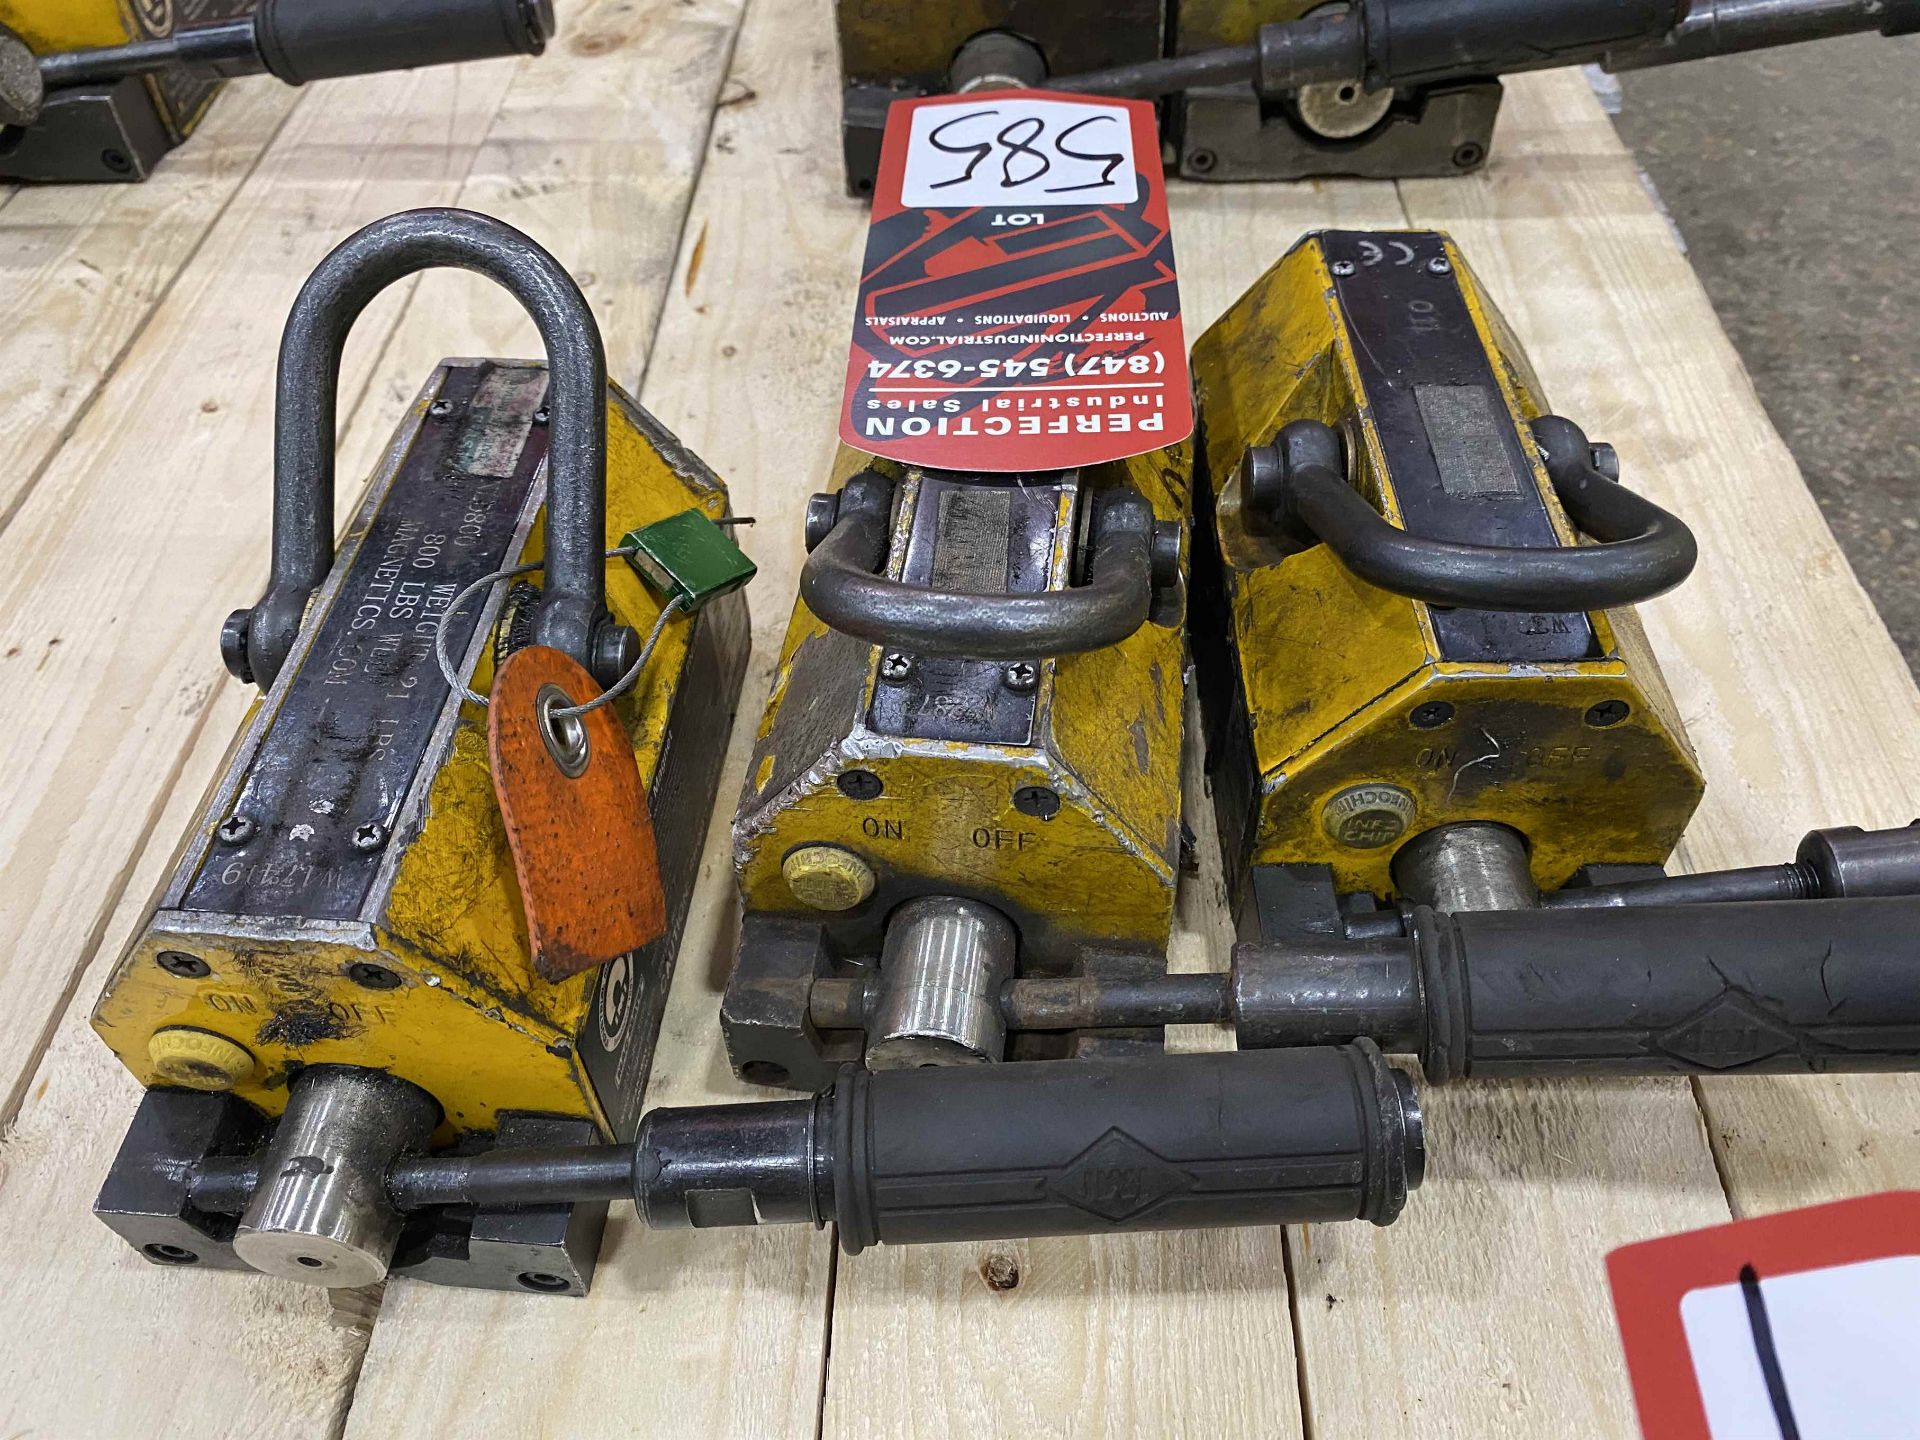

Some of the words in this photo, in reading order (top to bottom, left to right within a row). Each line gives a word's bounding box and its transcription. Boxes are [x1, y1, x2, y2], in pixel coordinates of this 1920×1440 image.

[928, 111, 1125, 193] 585
[991, 213, 1044, 226] LOT
[865, 315, 946, 327] APPRAISALS
[974, 313, 1071, 325] LIQUIDATIONS
[1099, 311, 1169, 323] AUCTIONS
[889, 331, 1145, 345] PERFECTIONINDUSTRIAL.COM
[867, 357, 1051, 380] 545-6374
[1064, 350, 1165, 377] (847)
[866, 398, 960, 413] Sales
[981, 394, 1164, 412] Industrial
[865, 412, 1164, 436] PERFECTION
[412, 534, 446, 569] 800
[389, 582, 426, 619] LBS
[1415, 748, 1457, 769] ON
[1526, 747, 1592, 768] OFF
[862, 817, 904, 841] ON
[973, 827, 1038, 852] OFF
[207, 992, 257, 1014] ON
[329, 1001, 398, 1025] OFF
